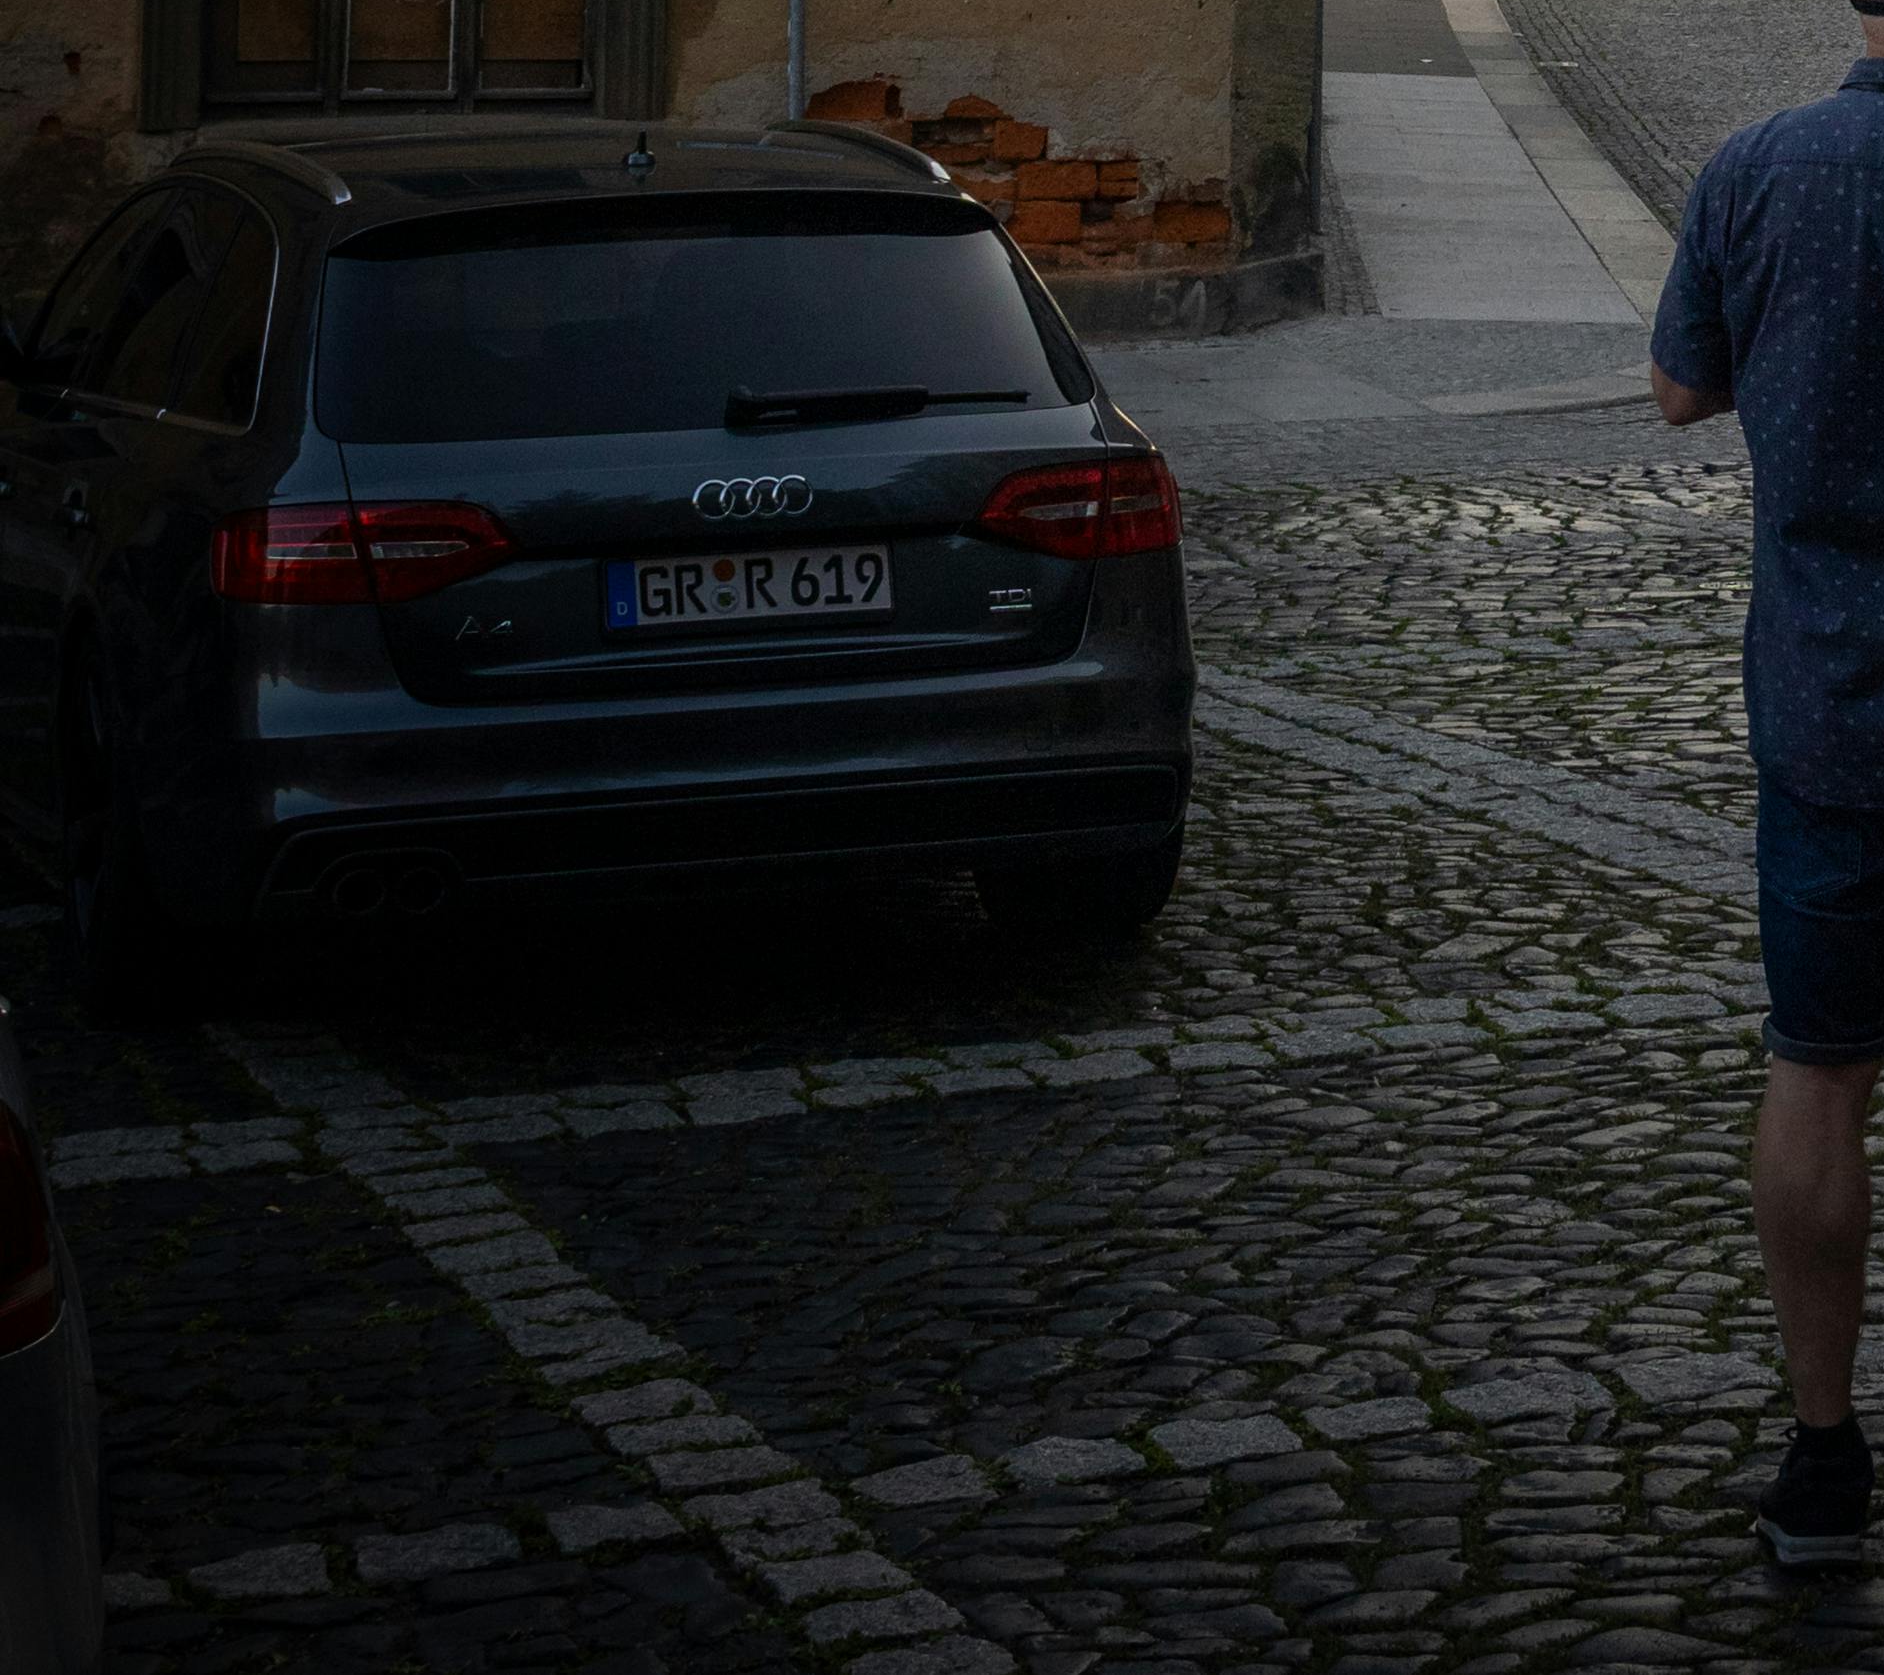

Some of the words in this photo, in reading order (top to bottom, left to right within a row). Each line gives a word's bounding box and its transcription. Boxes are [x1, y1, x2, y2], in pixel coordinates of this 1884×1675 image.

[639, 563, 707, 617] GR
[744, 557, 777, 609] R
[791, 552, 884, 606] 619
[989, 588, 1032, 603] TDI
[616, 601, 628, 616] D
[456, 615, 514, 640] A4
